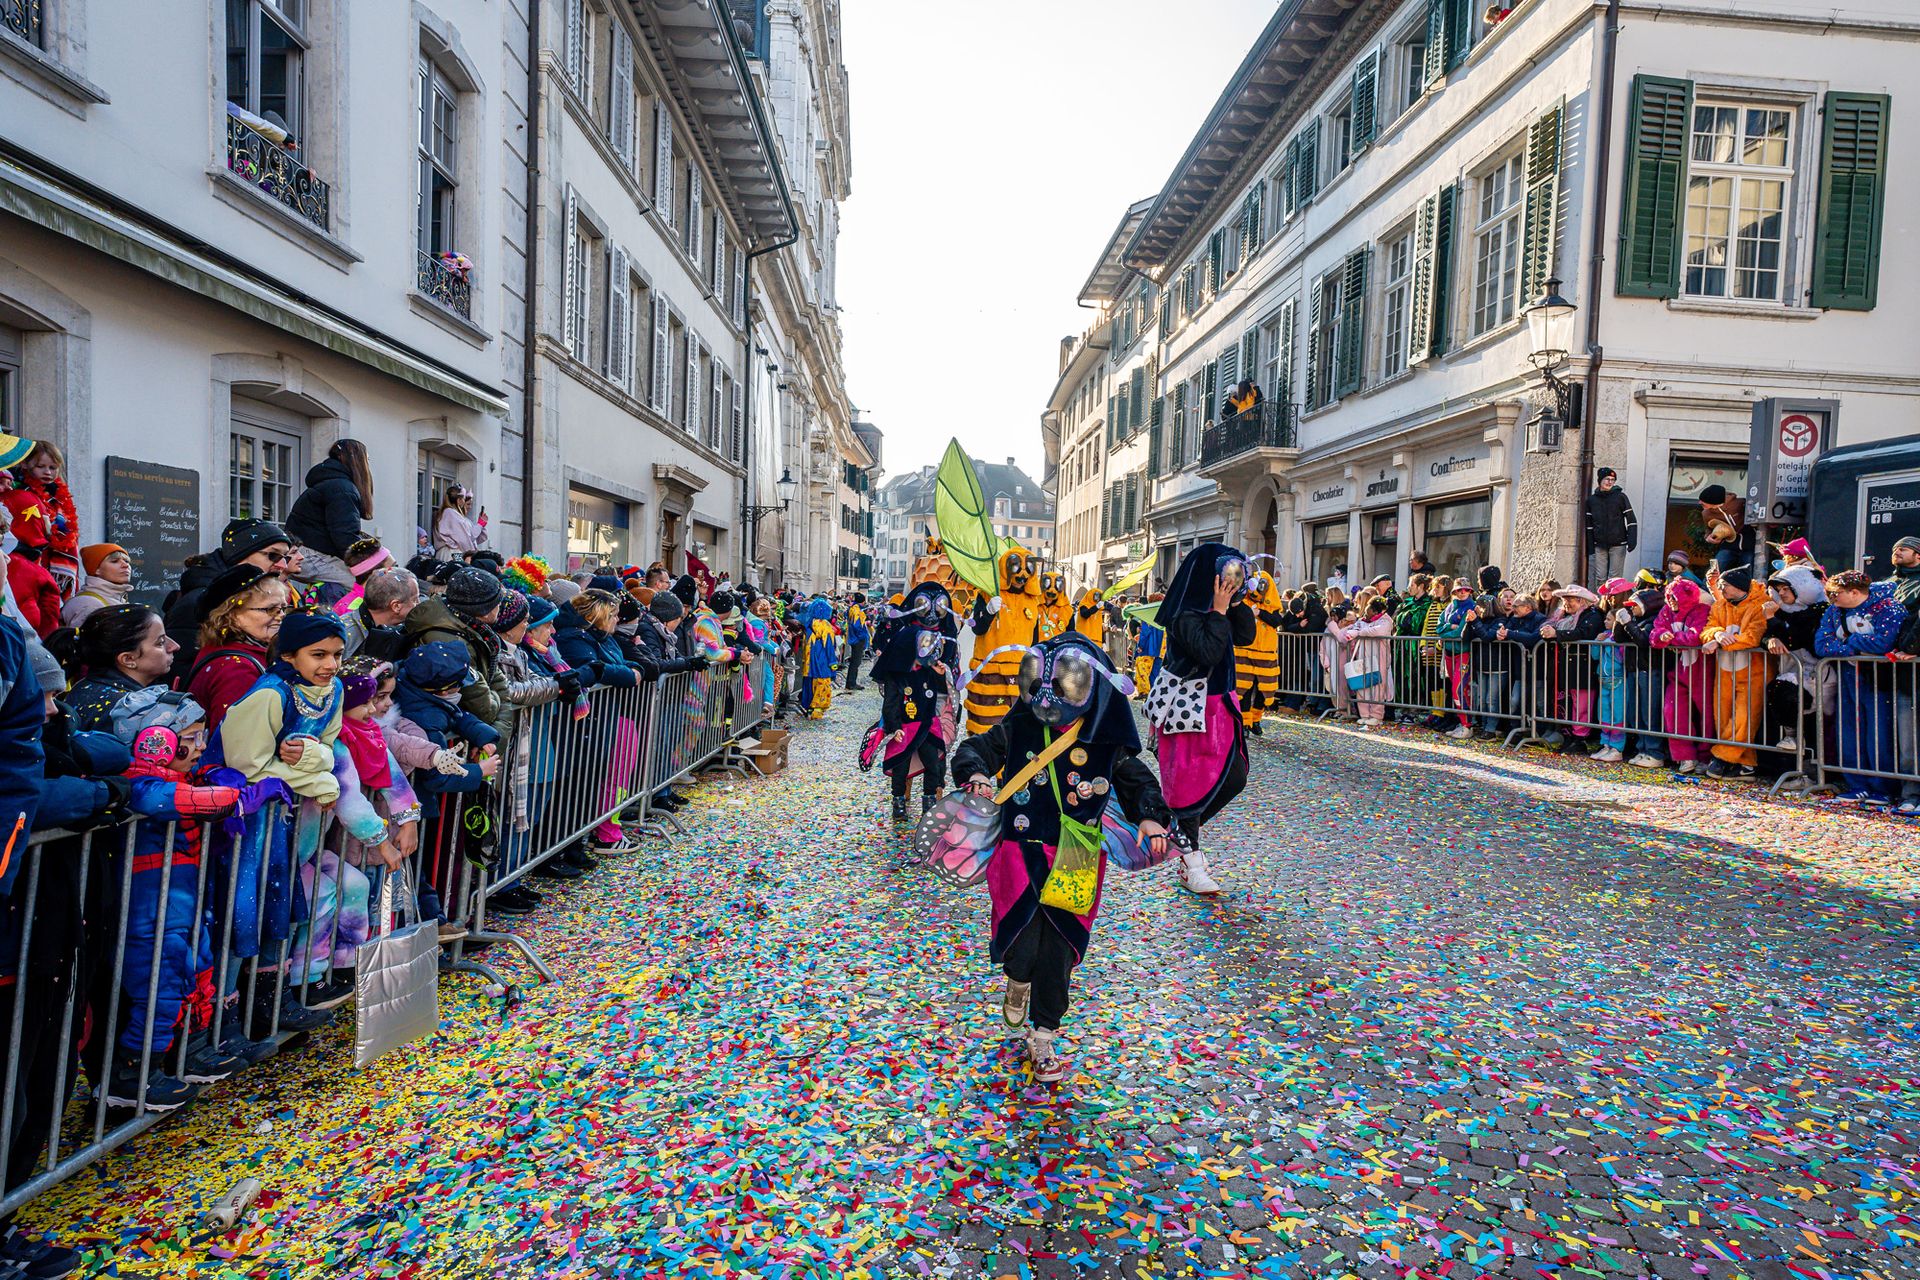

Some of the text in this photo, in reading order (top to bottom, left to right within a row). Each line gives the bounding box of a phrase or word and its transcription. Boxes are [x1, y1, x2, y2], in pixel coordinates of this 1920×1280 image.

[1430, 456, 1476, 477] Confiseur
[1777, 463, 1808, 472] otelgäs
[128, 471, 143, 480] vins
[143, 474, 165, 483] servis
[174, 479, 192, 488] verre
[1786, 473, 1808, 485] Gepä
[1313, 485, 1345, 503] Chocolatier
